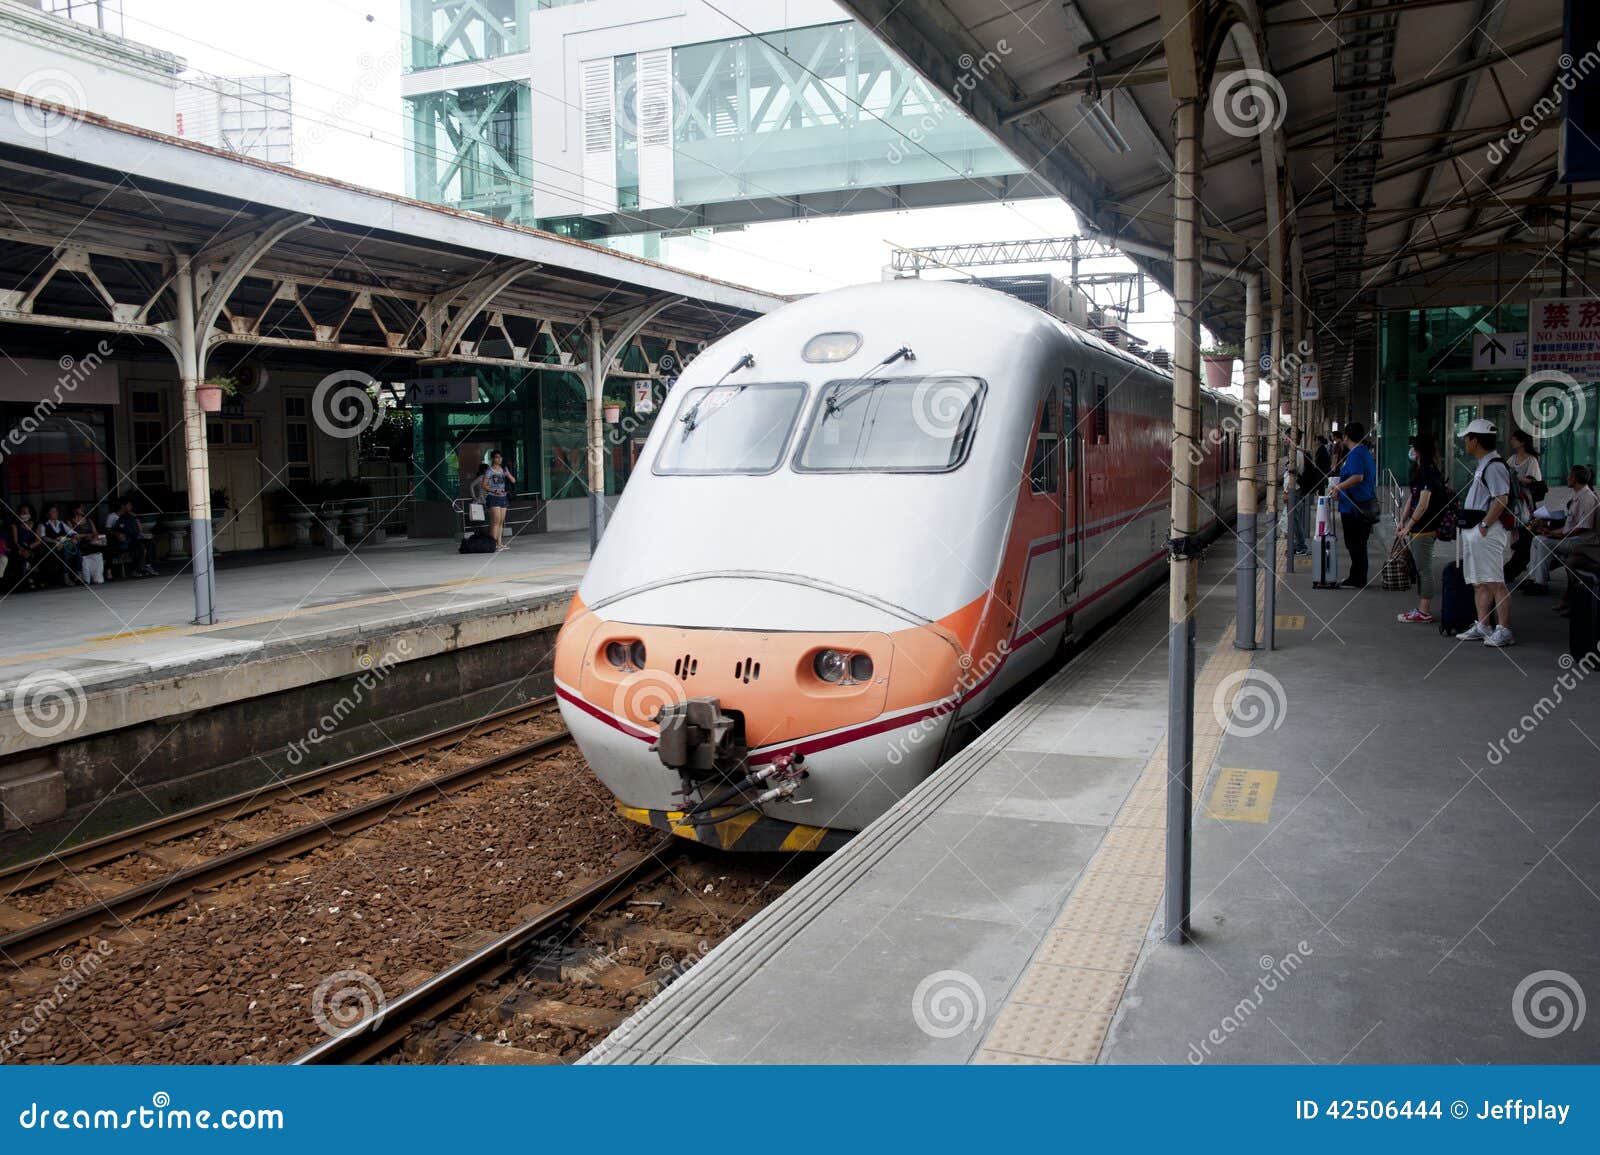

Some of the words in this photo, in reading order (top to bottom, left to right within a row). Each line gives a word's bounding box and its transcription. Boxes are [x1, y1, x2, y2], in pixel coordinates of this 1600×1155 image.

[1536, 332, 1552, 342] NO
[1303, 375, 1313, 388] 7
[638, 390, 647, 401] 7
